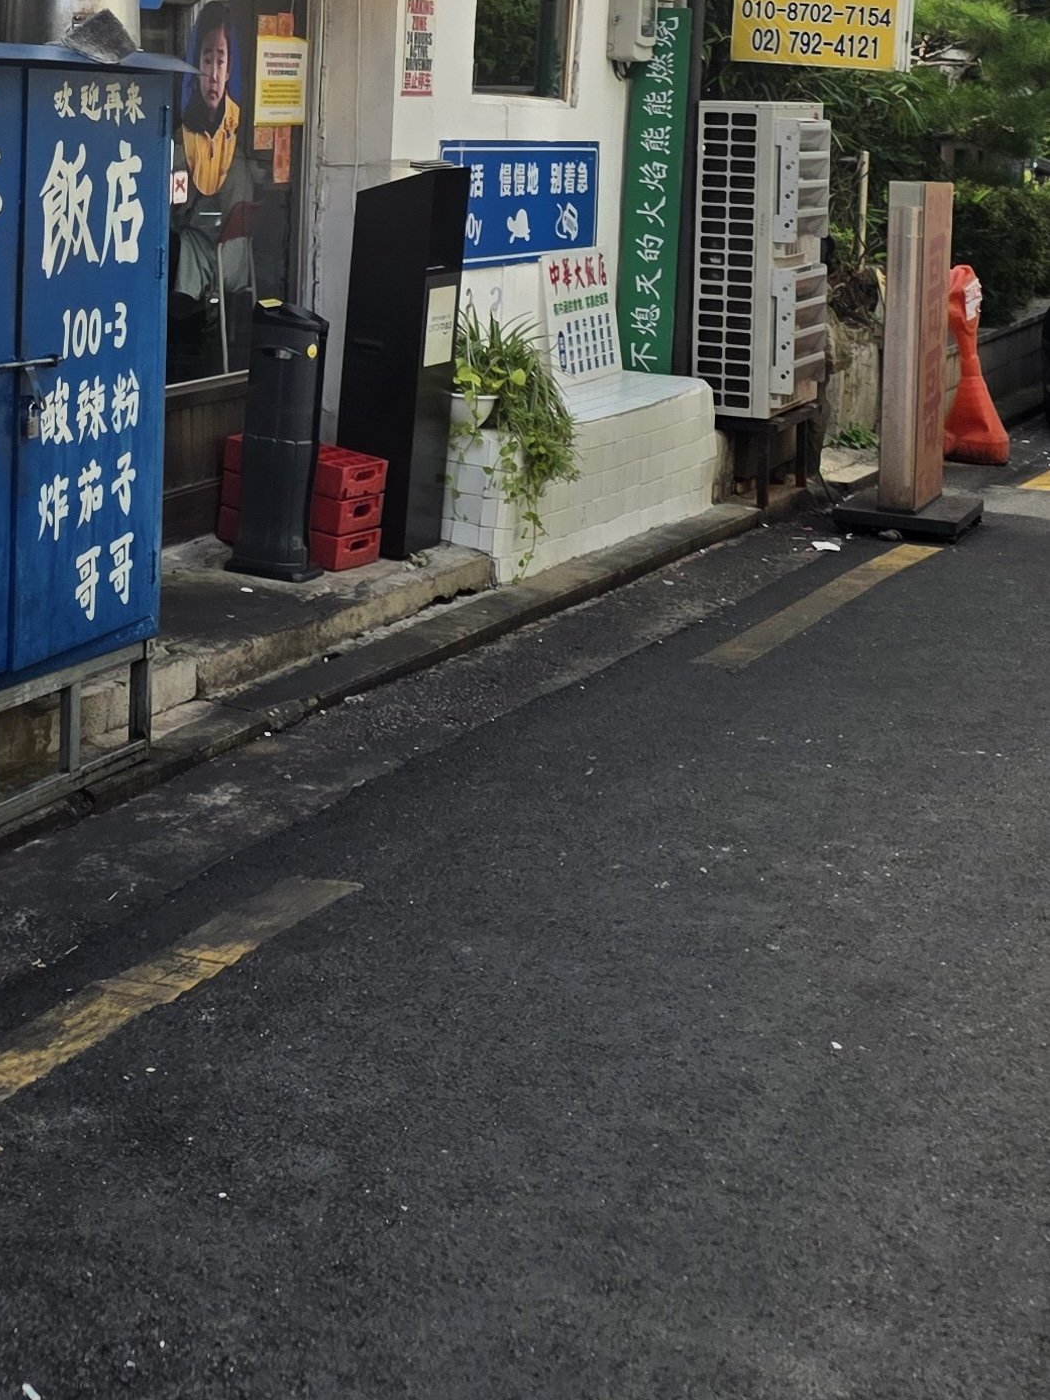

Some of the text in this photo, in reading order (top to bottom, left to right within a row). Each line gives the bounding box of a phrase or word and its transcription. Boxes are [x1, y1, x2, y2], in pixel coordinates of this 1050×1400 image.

[742, 0, 891, 27] 010-8702-7154
[752, 28, 878, 59] 02) 792-4121
[53, 80, 146, 128] 欢迎再来
[62, 302, 127, 359] 100-3
[40, 368, 140, 446] 酸辣粉
[38, 452, 136, 541] 炸茄子
[74, 532, 135, 621] 哥哥
